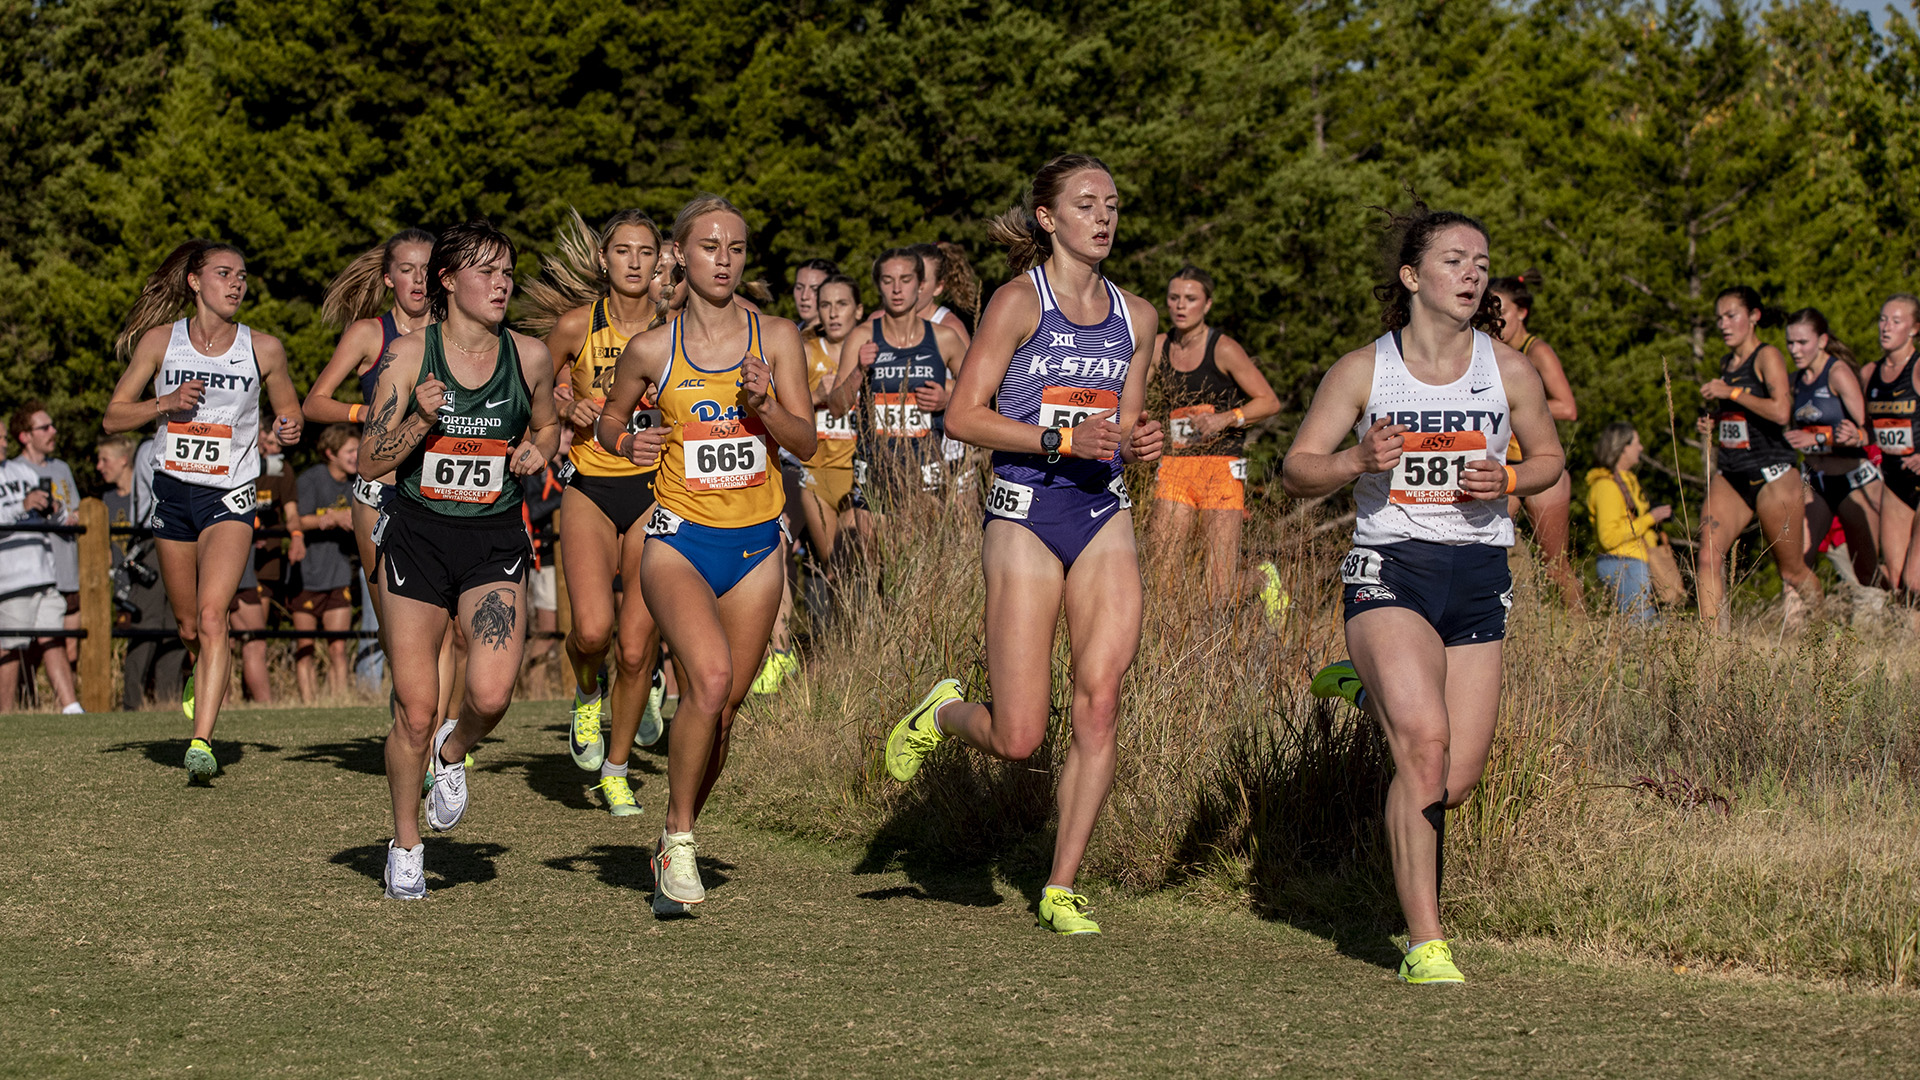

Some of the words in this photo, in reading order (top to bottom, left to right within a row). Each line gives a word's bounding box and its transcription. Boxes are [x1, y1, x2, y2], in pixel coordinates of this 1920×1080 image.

[1049, 331, 1077, 348] XII
[875, 365, 934, 379] BUTLER
[165, 370, 254, 392] LIBERTY
[677, 379, 706, 388] ACC
[1069, 390, 1097, 406] OSU
[446, 424, 487, 435] STATE
[710, 422, 740, 438] OSU
[1879, 430, 1906, 445] 602
[175, 438, 220, 462] 575
[452, 440, 482, 454] OSU
[1421, 434, 1455, 451] OSU
[697, 441, 755, 473] 665
[435, 458, 491, 487] 675
[699, 473, 755, 484] WEIS-CROCKETT
[1404, 455, 1466, 486] 581
[353, 478, 372, 500] 14
[709, 480, 747, 488] INVITATIONAL
[434, 488, 489, 497] WEIS-CROCKETT
